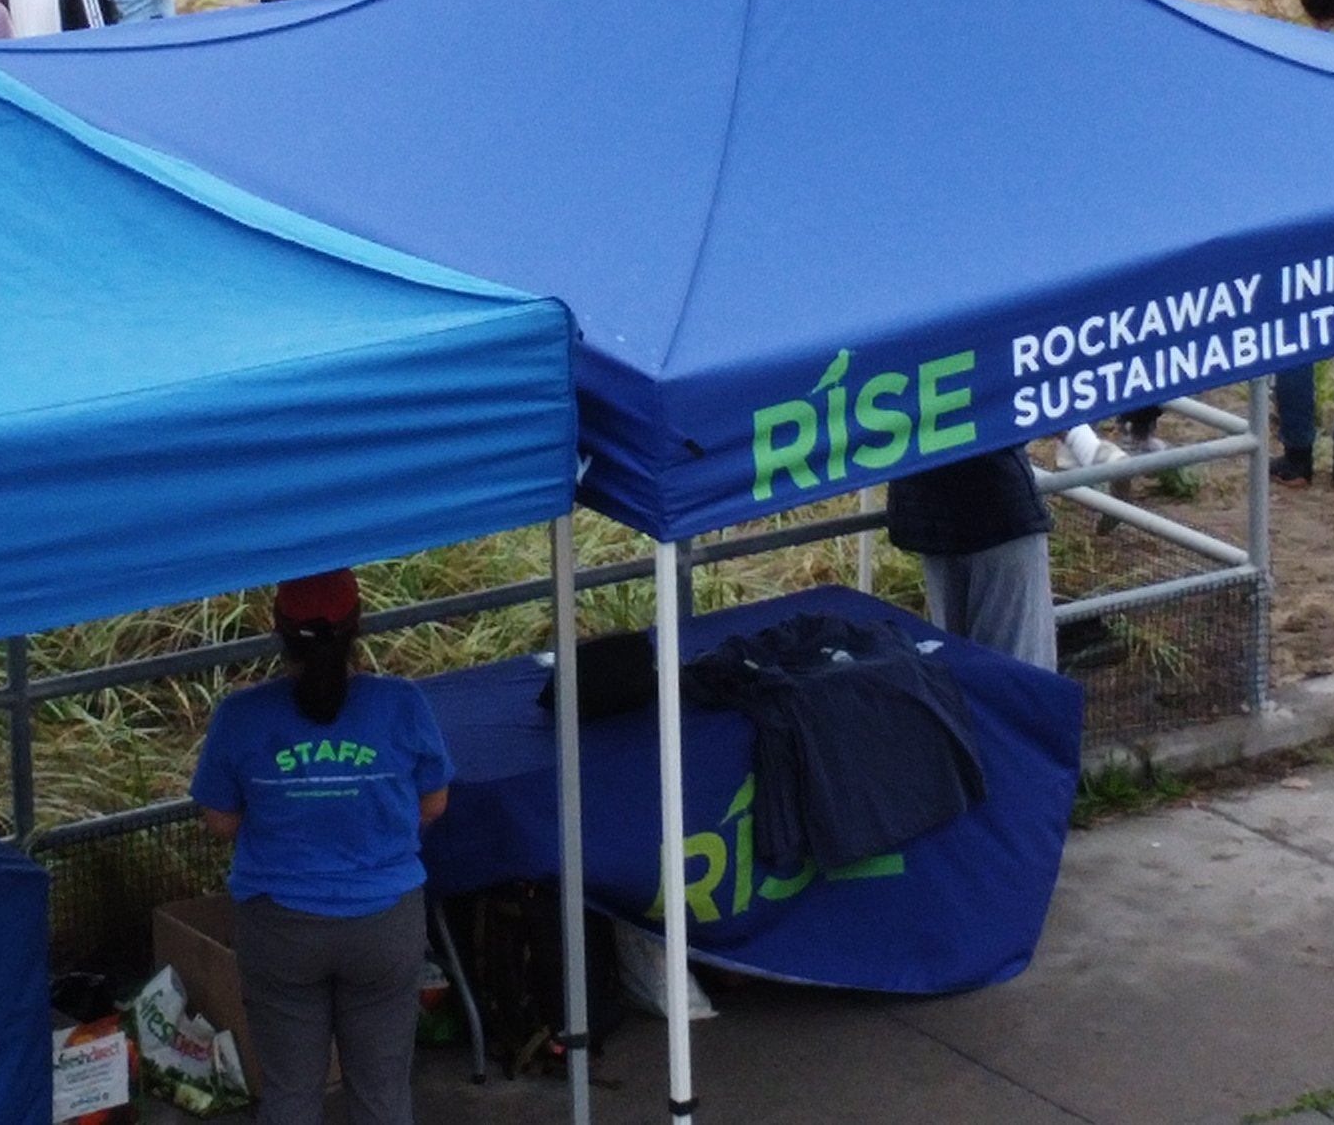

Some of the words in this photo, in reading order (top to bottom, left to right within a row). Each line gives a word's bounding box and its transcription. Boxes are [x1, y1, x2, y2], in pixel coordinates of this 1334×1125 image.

[1012, 274, 1261, 377] ROCKAWAY
[275, 739, 377, 772] STAFF
[644, 812, 905, 924] RI
